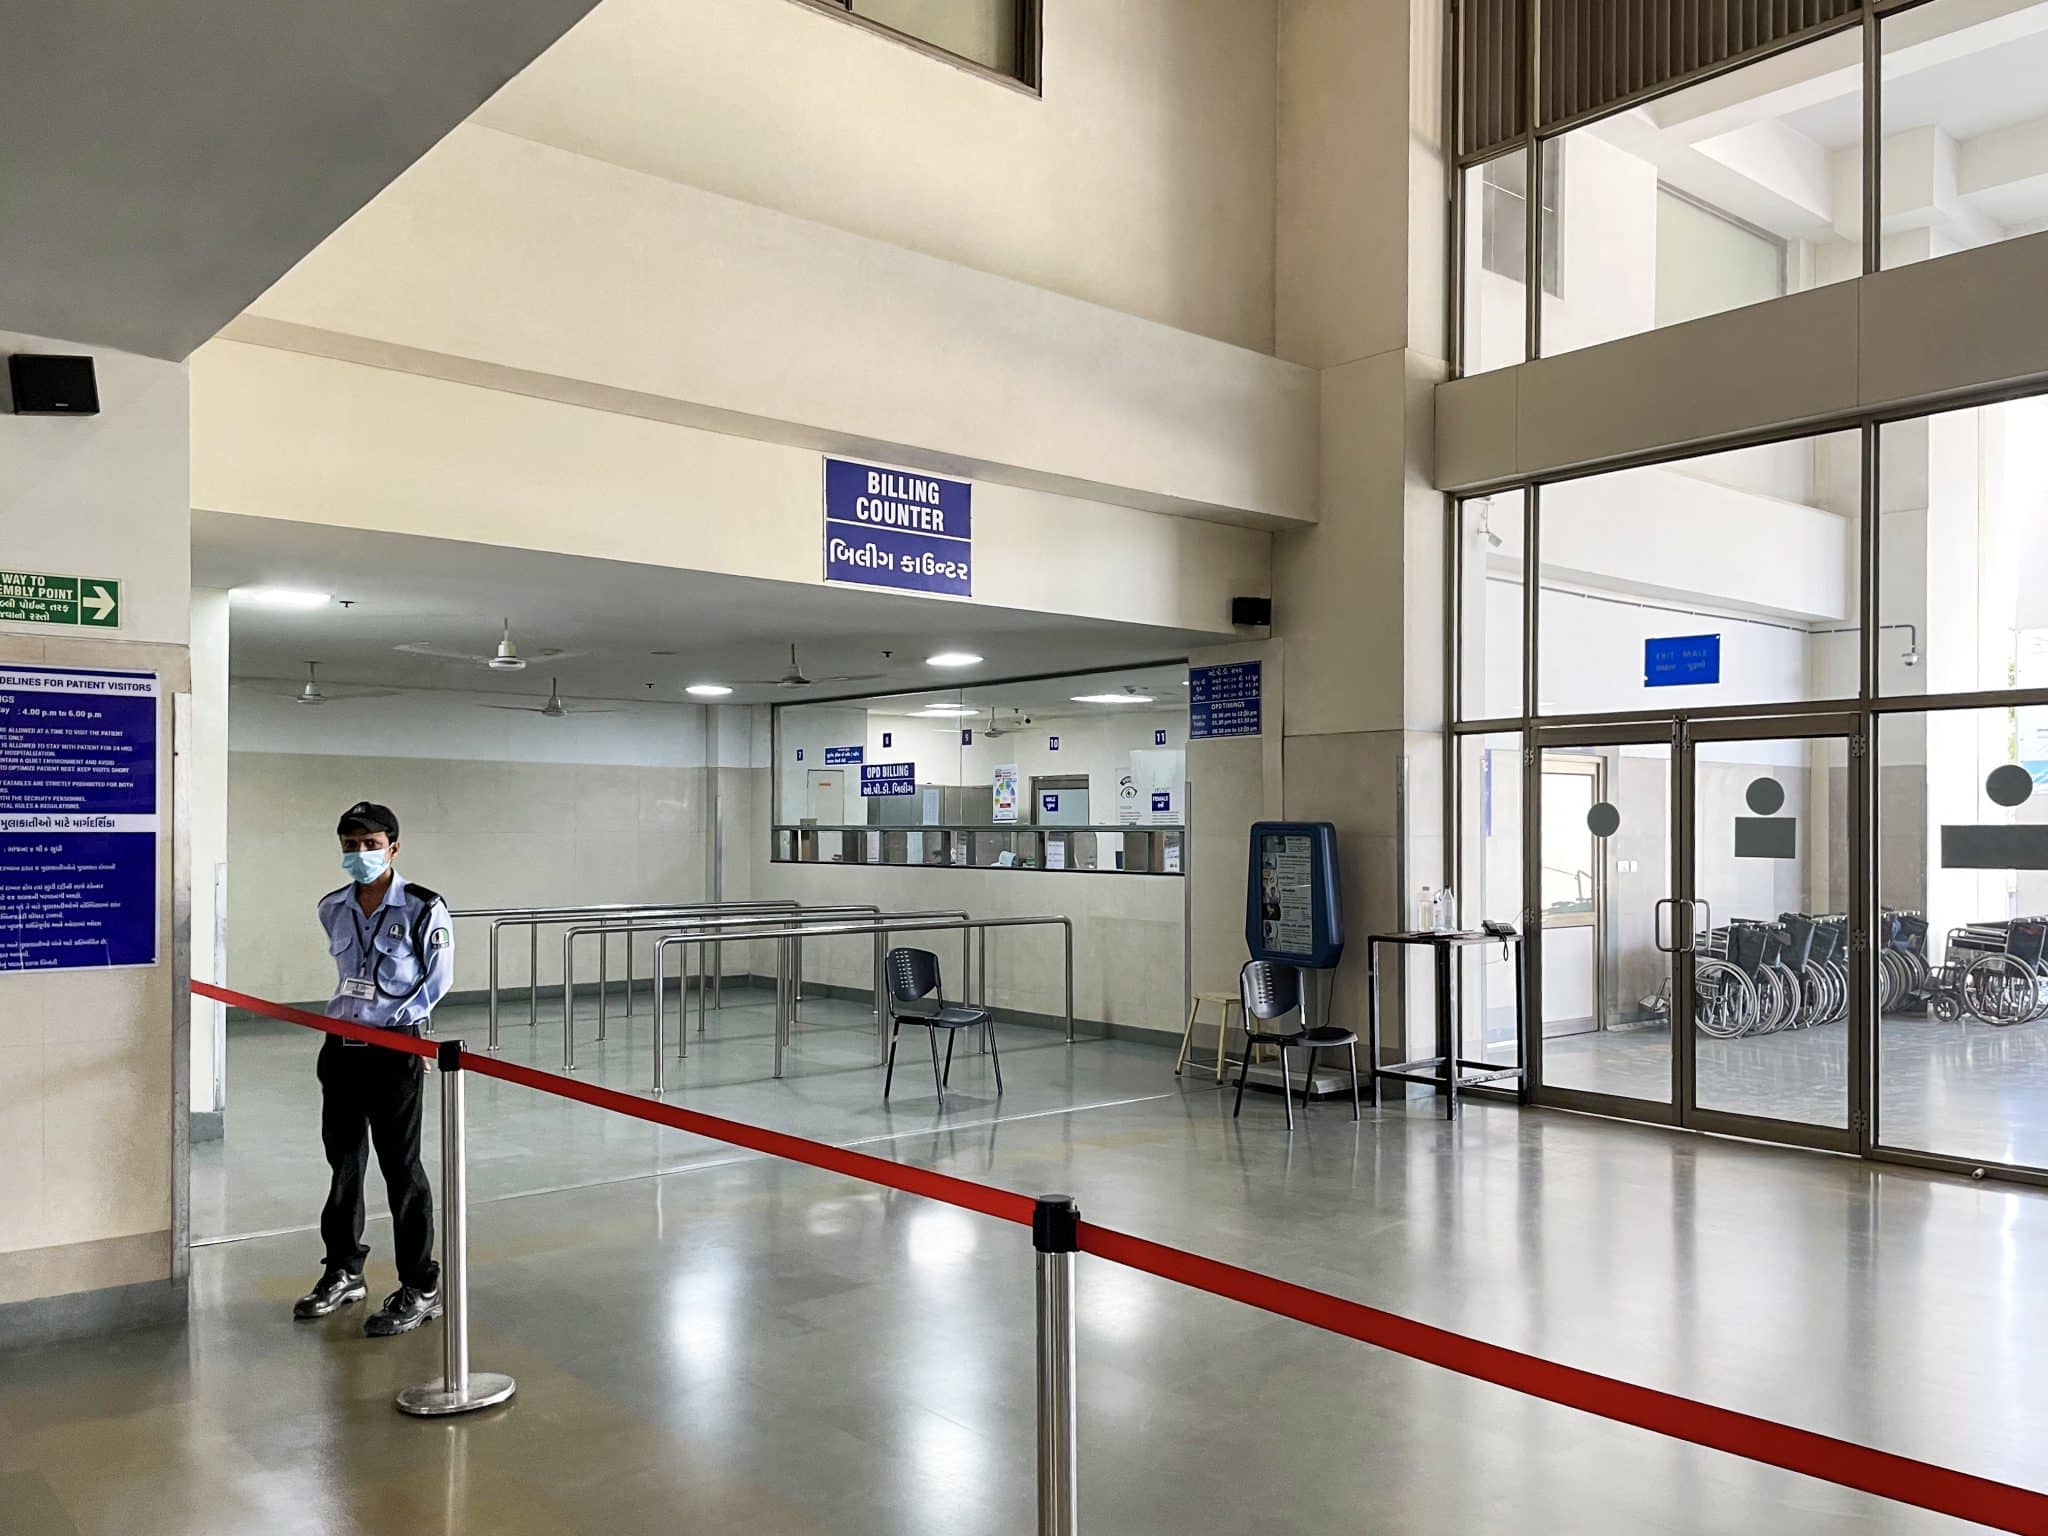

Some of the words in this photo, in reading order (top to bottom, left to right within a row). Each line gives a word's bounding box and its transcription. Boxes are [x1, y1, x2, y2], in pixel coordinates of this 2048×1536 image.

[868, 471, 940, 505] BILLING
[856, 496, 944, 532] COUNTER
[900, 552, 968, 581] કાઉન્ટર
[1, 573, 27, 585] WAY
[30, 575, 46, 586] TO
[38, 587, 74, 600] POINT
[43, 678, 65, 688] FOR
[66, 679, 106, 690] PATIENT
[107, 681, 152, 692] VISITORS
[1050, 738, 1059, 749] 10
[1156, 732, 1166, 743] 11
[866, 766, 881, 779] OPD
[882, 764, 909, 778] BILLING
[54, 816, 71, 828] માટે
